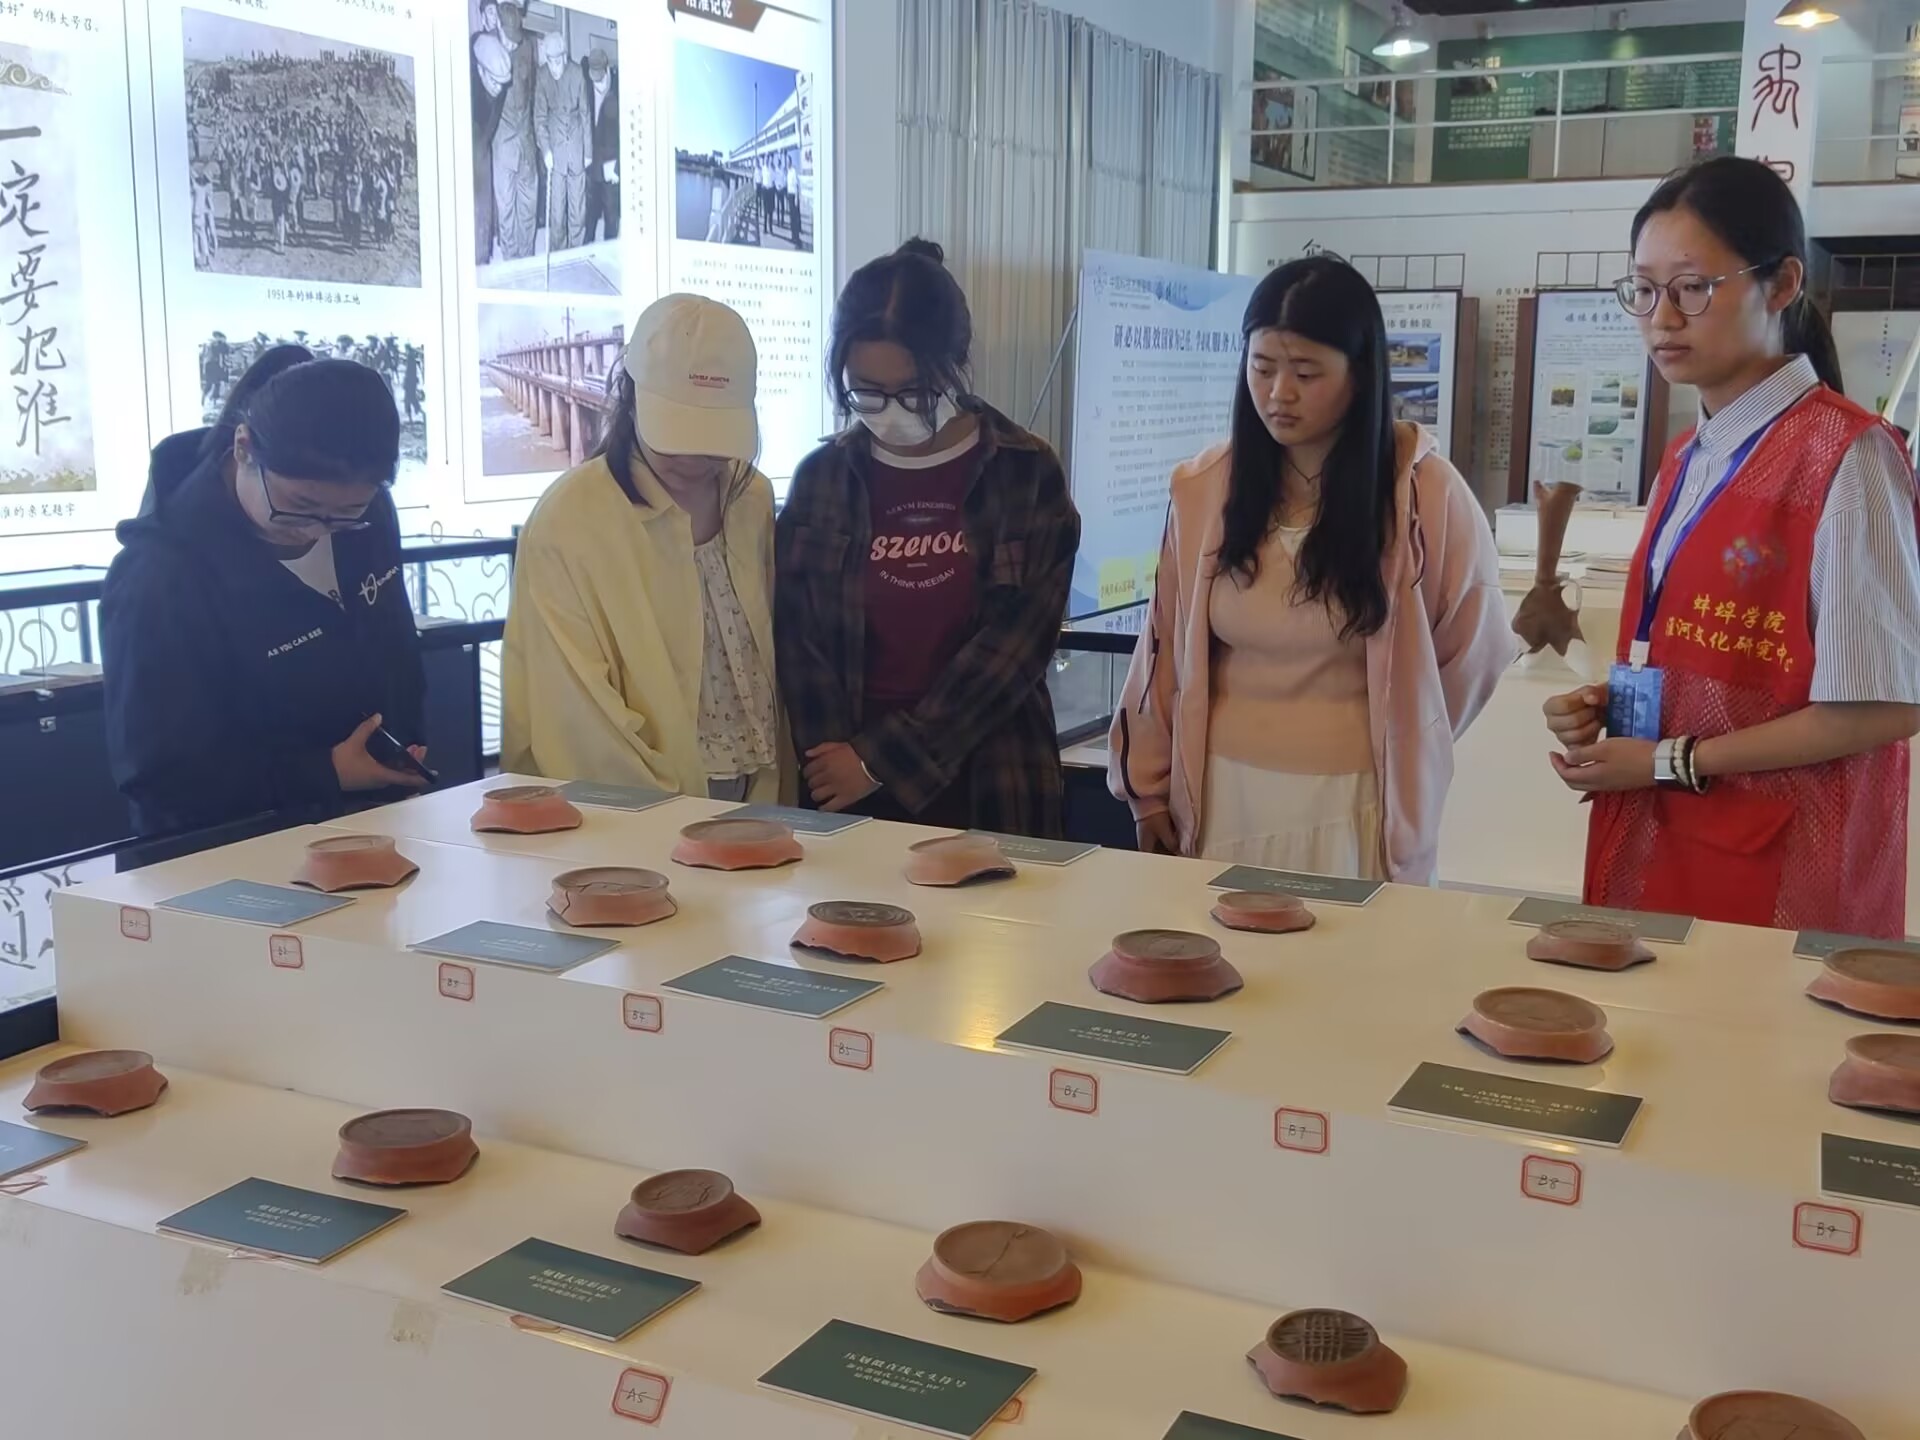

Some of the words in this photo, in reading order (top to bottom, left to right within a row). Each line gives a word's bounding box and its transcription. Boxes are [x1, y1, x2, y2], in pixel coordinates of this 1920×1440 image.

[1693, 594, 1786, 634] 蚌埠学院
[1287, 1123, 1307, 1140] B7
[1537, 1174, 1560, 1190] B8
[625, 1387, 648, 1404] A5
